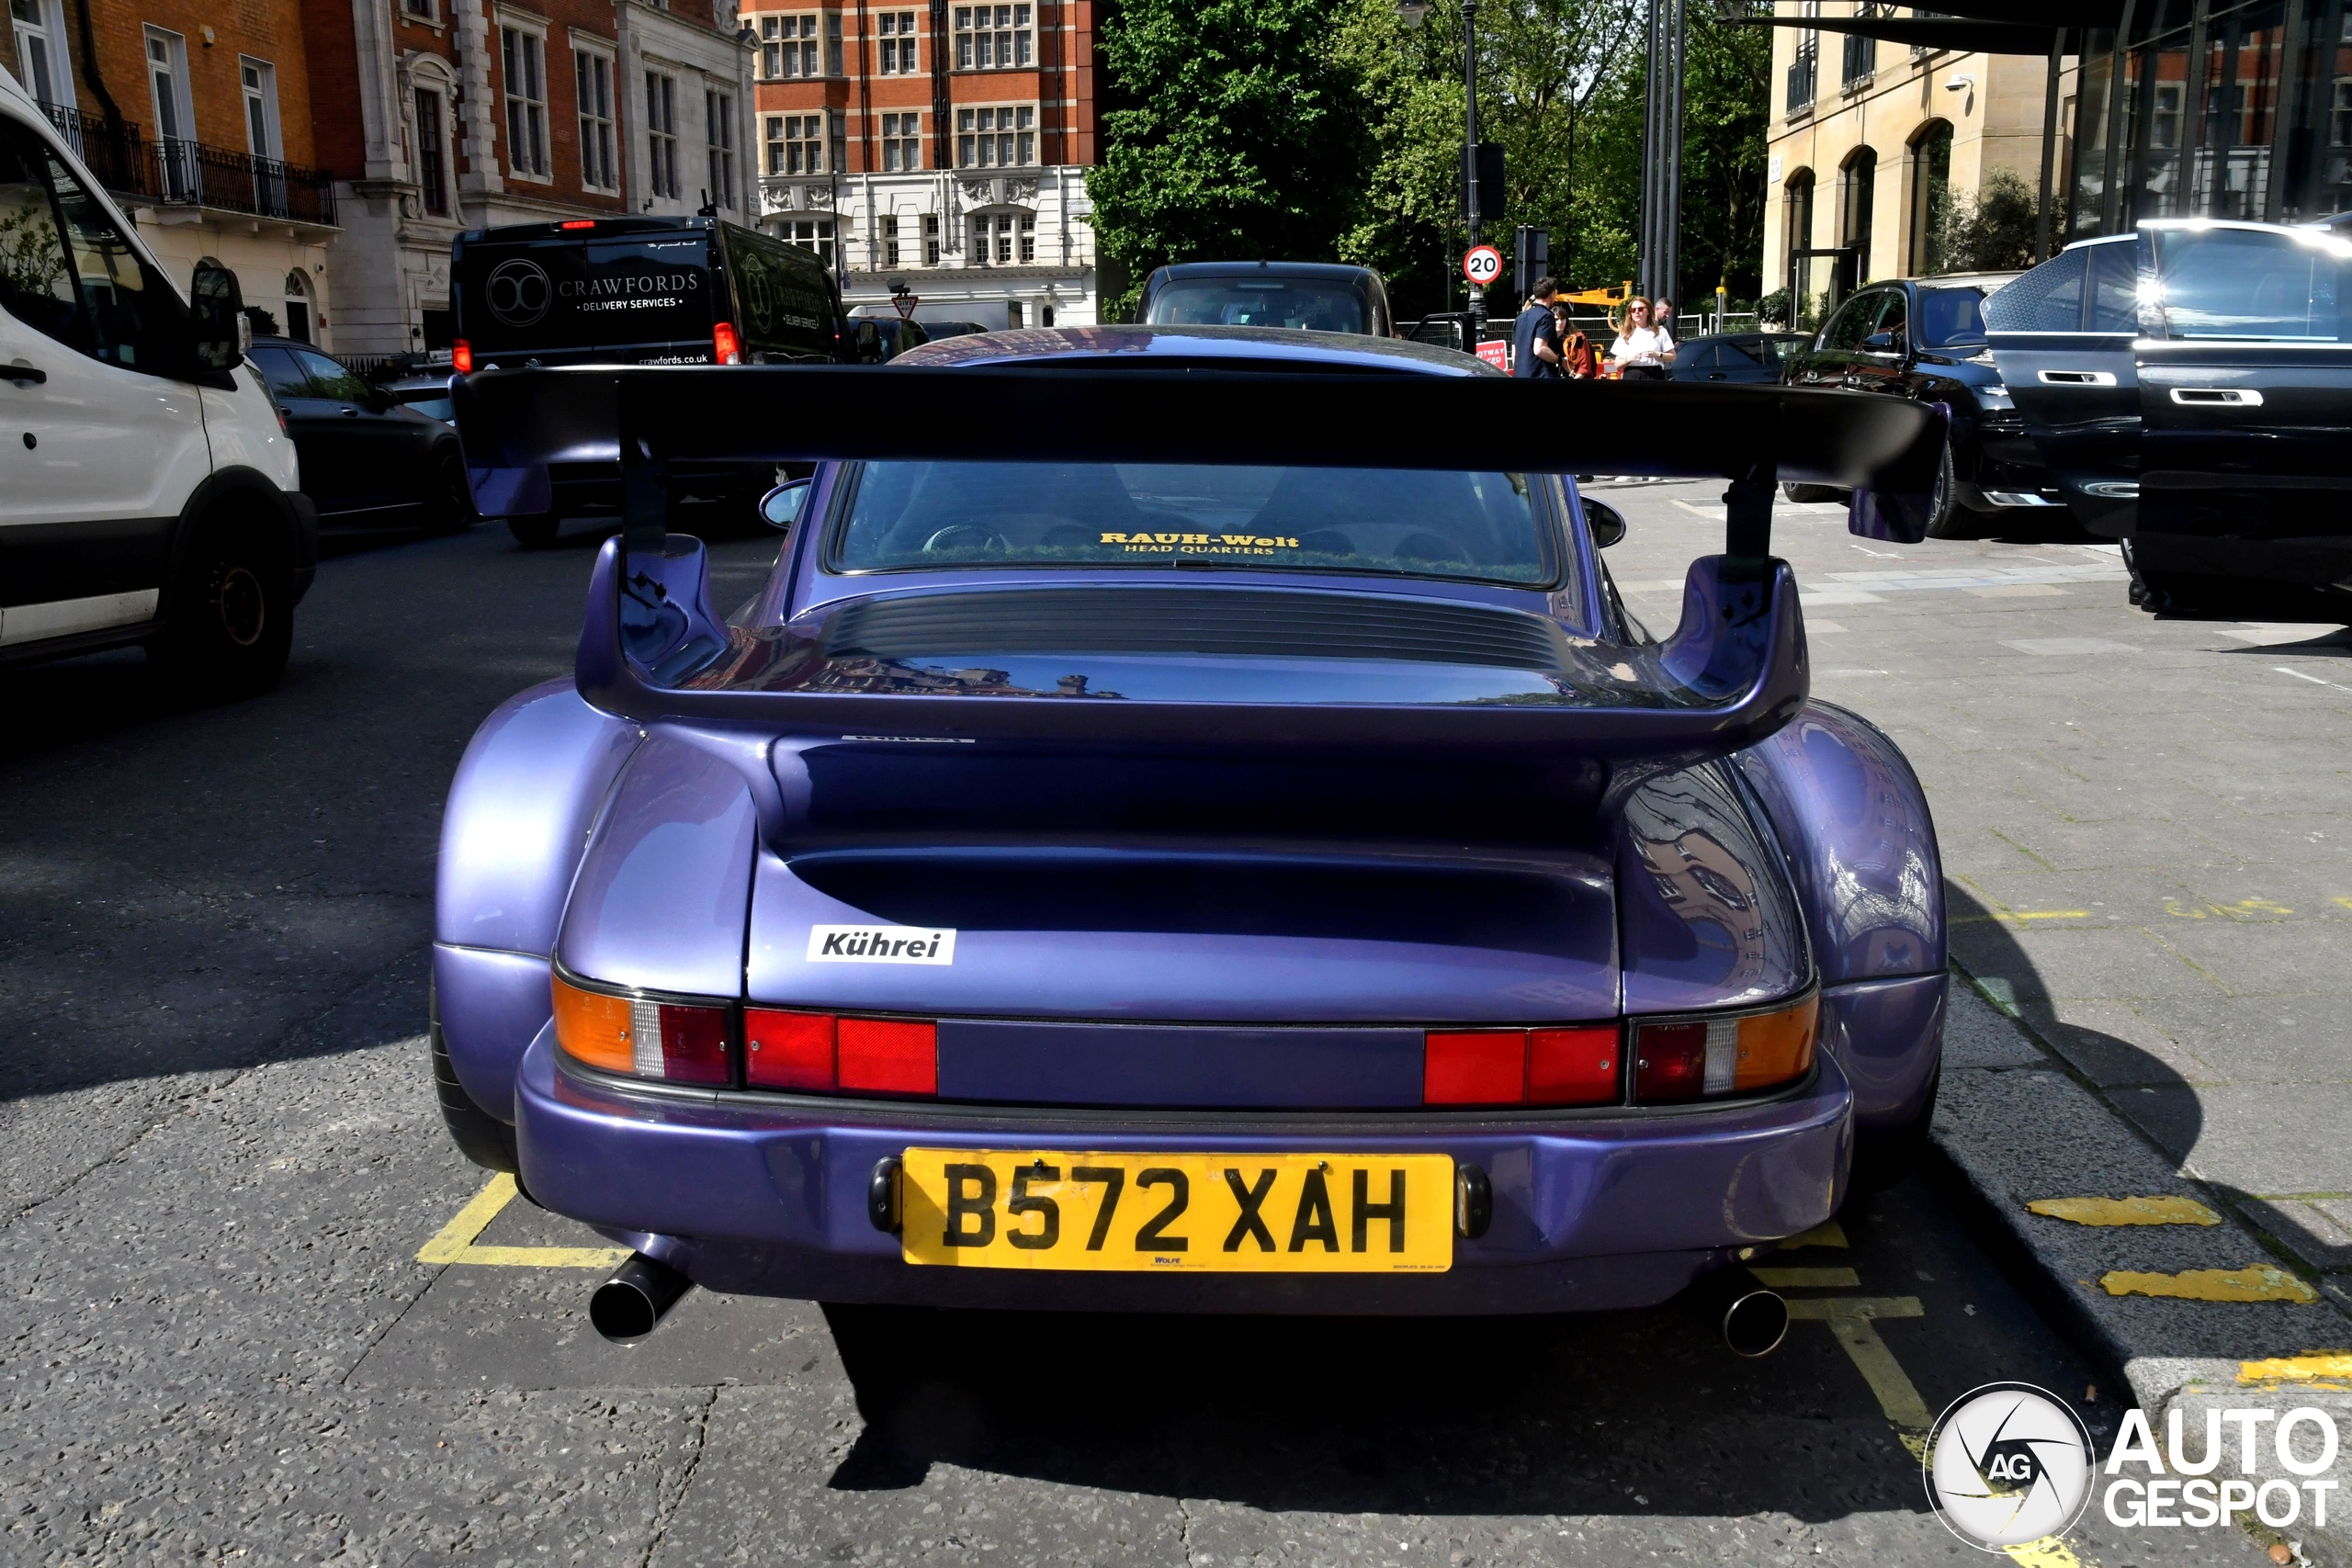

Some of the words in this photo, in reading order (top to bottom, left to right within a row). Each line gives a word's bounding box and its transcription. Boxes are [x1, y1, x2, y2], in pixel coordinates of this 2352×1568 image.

[1471, 257, 1496, 272] 20
[559, 274, 697, 297] CRAWFORDS
[582, 300, 628, 311] DELIVERY
[630, 298, 676, 309] SERVICES
[639, 354, 708, 366] crawfords.co.uk
[1100, 532, 1299, 548] RAUH-Welt
[1125, 545, 1173, 553] HEAD
[1180, 545, 1274, 556] QUARTERS
[821, 931, 942, 958] Kührei
[943, 1162, 1190, 1252] B572
[1222, 1168, 1406, 1254] XAH
